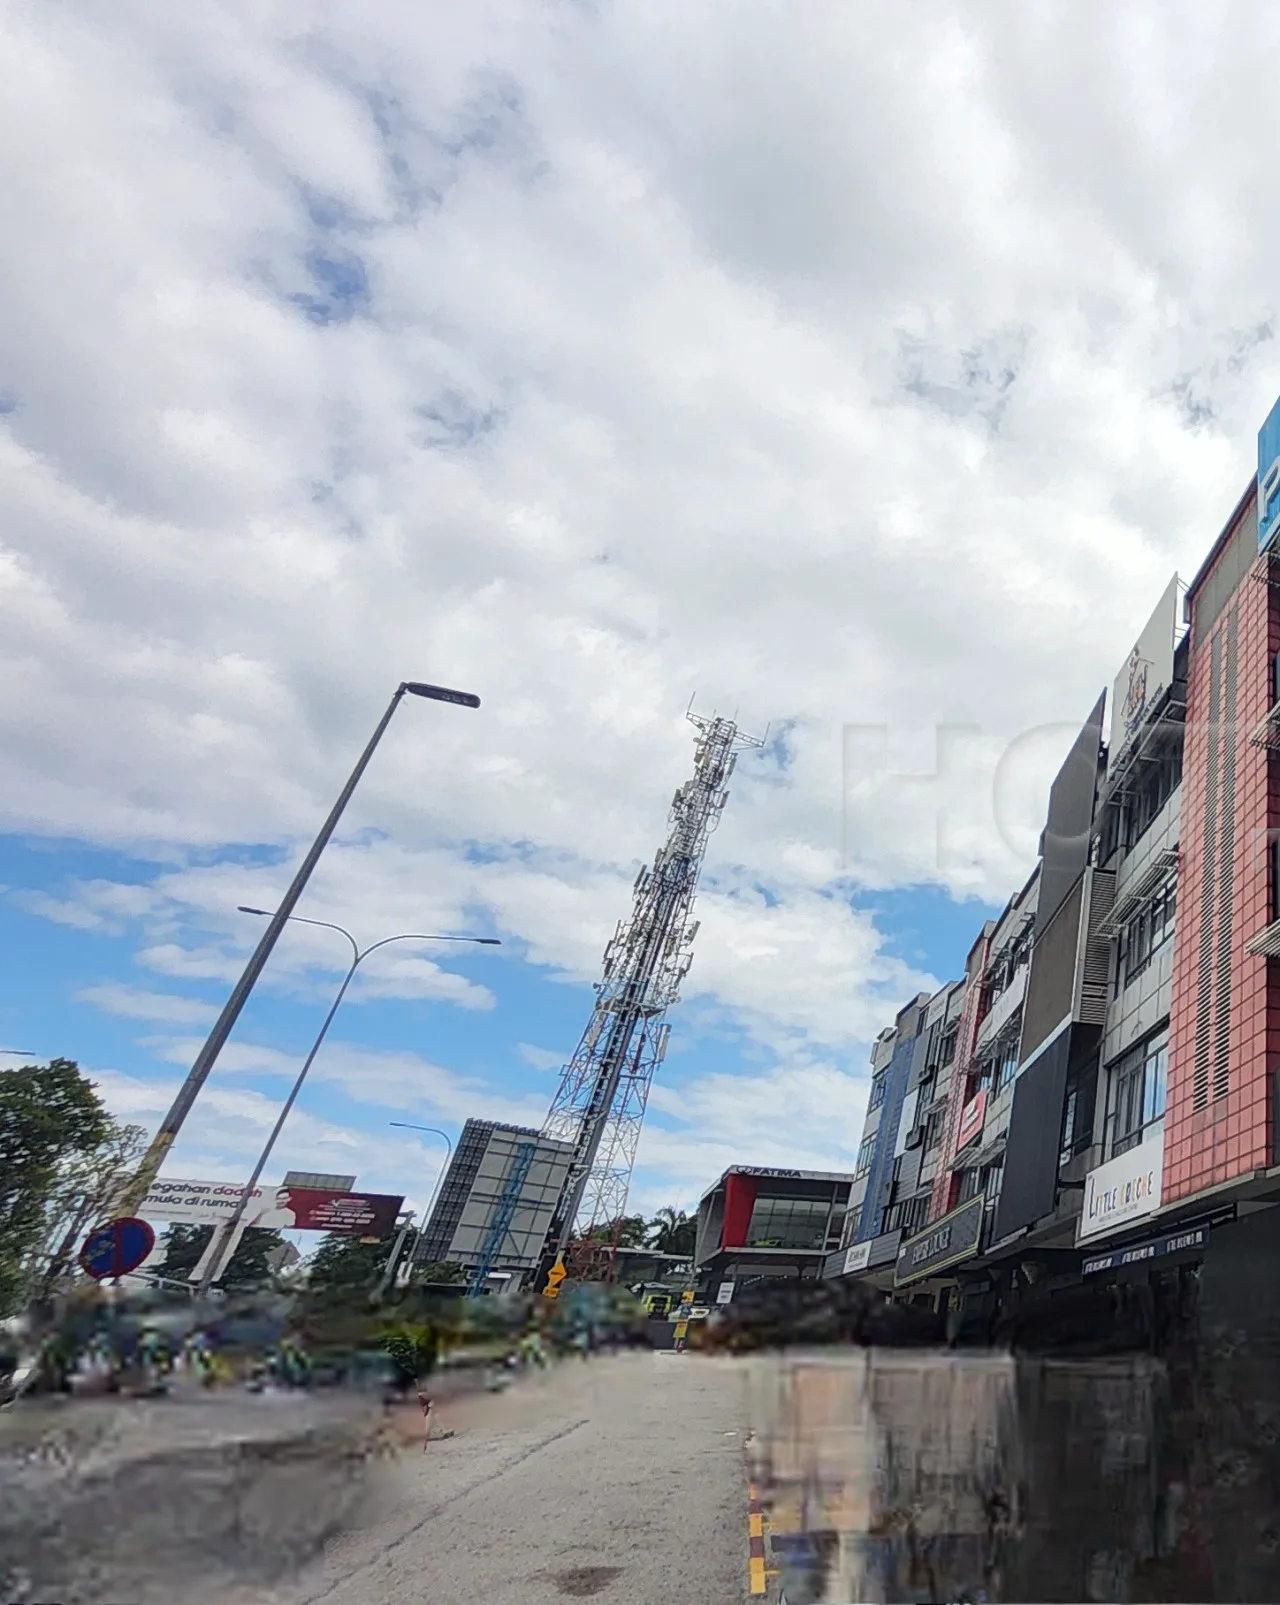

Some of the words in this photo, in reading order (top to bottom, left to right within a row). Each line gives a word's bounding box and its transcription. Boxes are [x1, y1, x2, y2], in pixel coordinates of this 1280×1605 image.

[753, 1166, 802, 1178] FATIMA
[151, 1183, 211, 1195] egahan
[144, 1194, 182, 1205] mula
[184, 1196, 199, 1206] di
[201, 1198, 241, 1209] ruma
